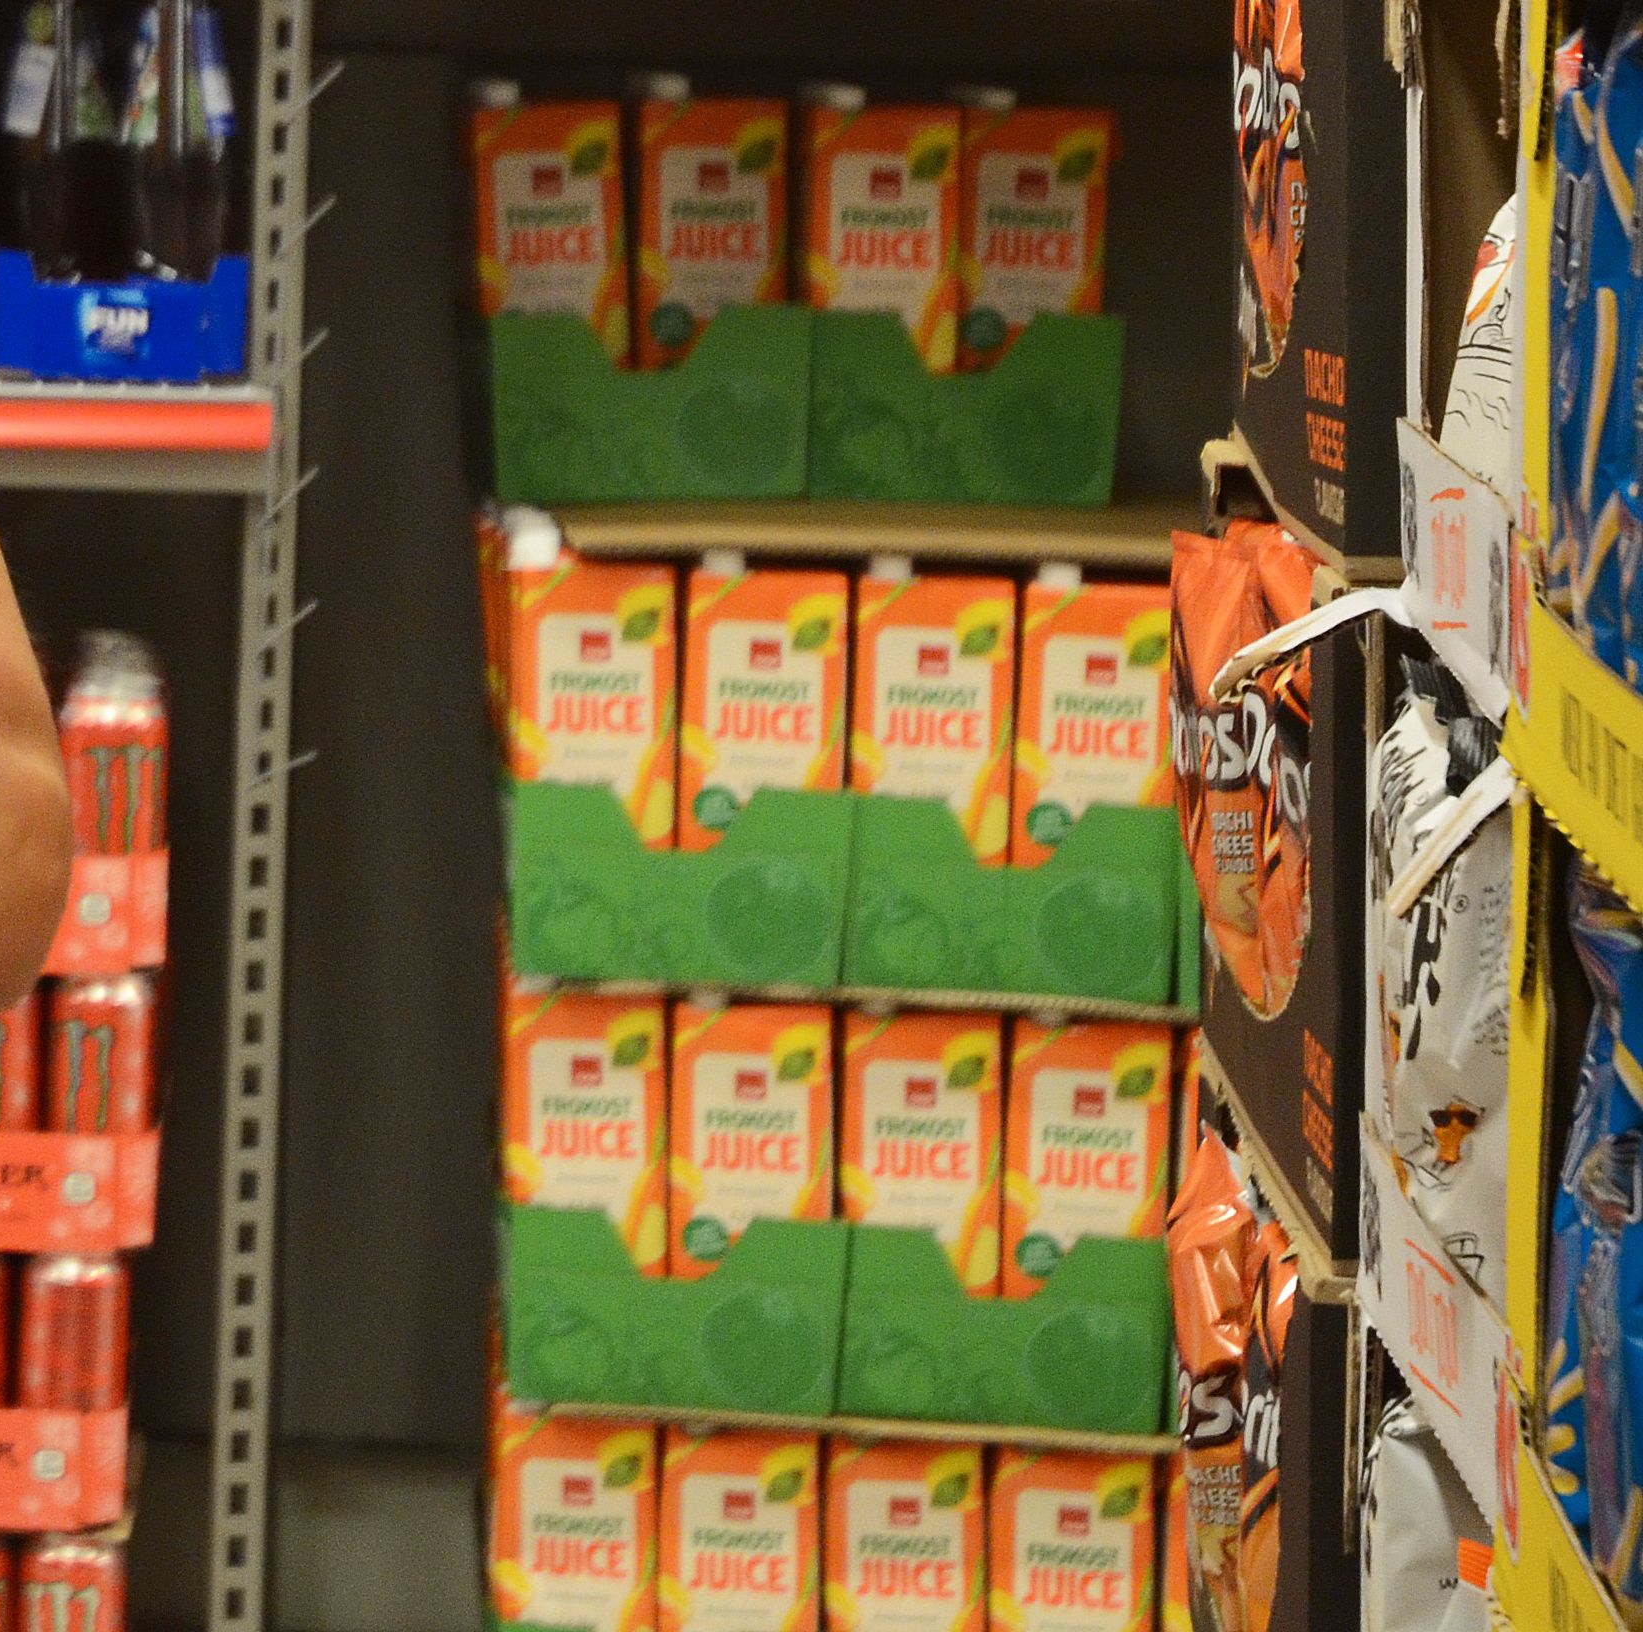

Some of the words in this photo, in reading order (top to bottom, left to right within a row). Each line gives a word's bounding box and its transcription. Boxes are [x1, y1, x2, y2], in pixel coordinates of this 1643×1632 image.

[507, 226, 596, 265] JUICE
[670, 222, 761, 261] JUICE
[838, 228, 933, 267] JUICE
[985, 229, 1079, 268] JUICE
[546, 694, 647, 735] JUICE
[713, 702, 815, 743] JUICE
[881, 708, 984, 748] JUICE
[1047, 717, 1149, 759] JUICE
[538, 1120, 637, 1159] JUICE
[701, 1134, 800, 1172] JUICE
[869, 1140, 971, 1181] JUICE
[1037, 1149, 1139, 1190] JUICE
[531, 1538, 628, 1577] JUICE
[689, 1550, 789, 1592] JUICE
[855, 1559, 955, 1598] JUICE
[1022, 1569, 1124, 1611] JUICE
